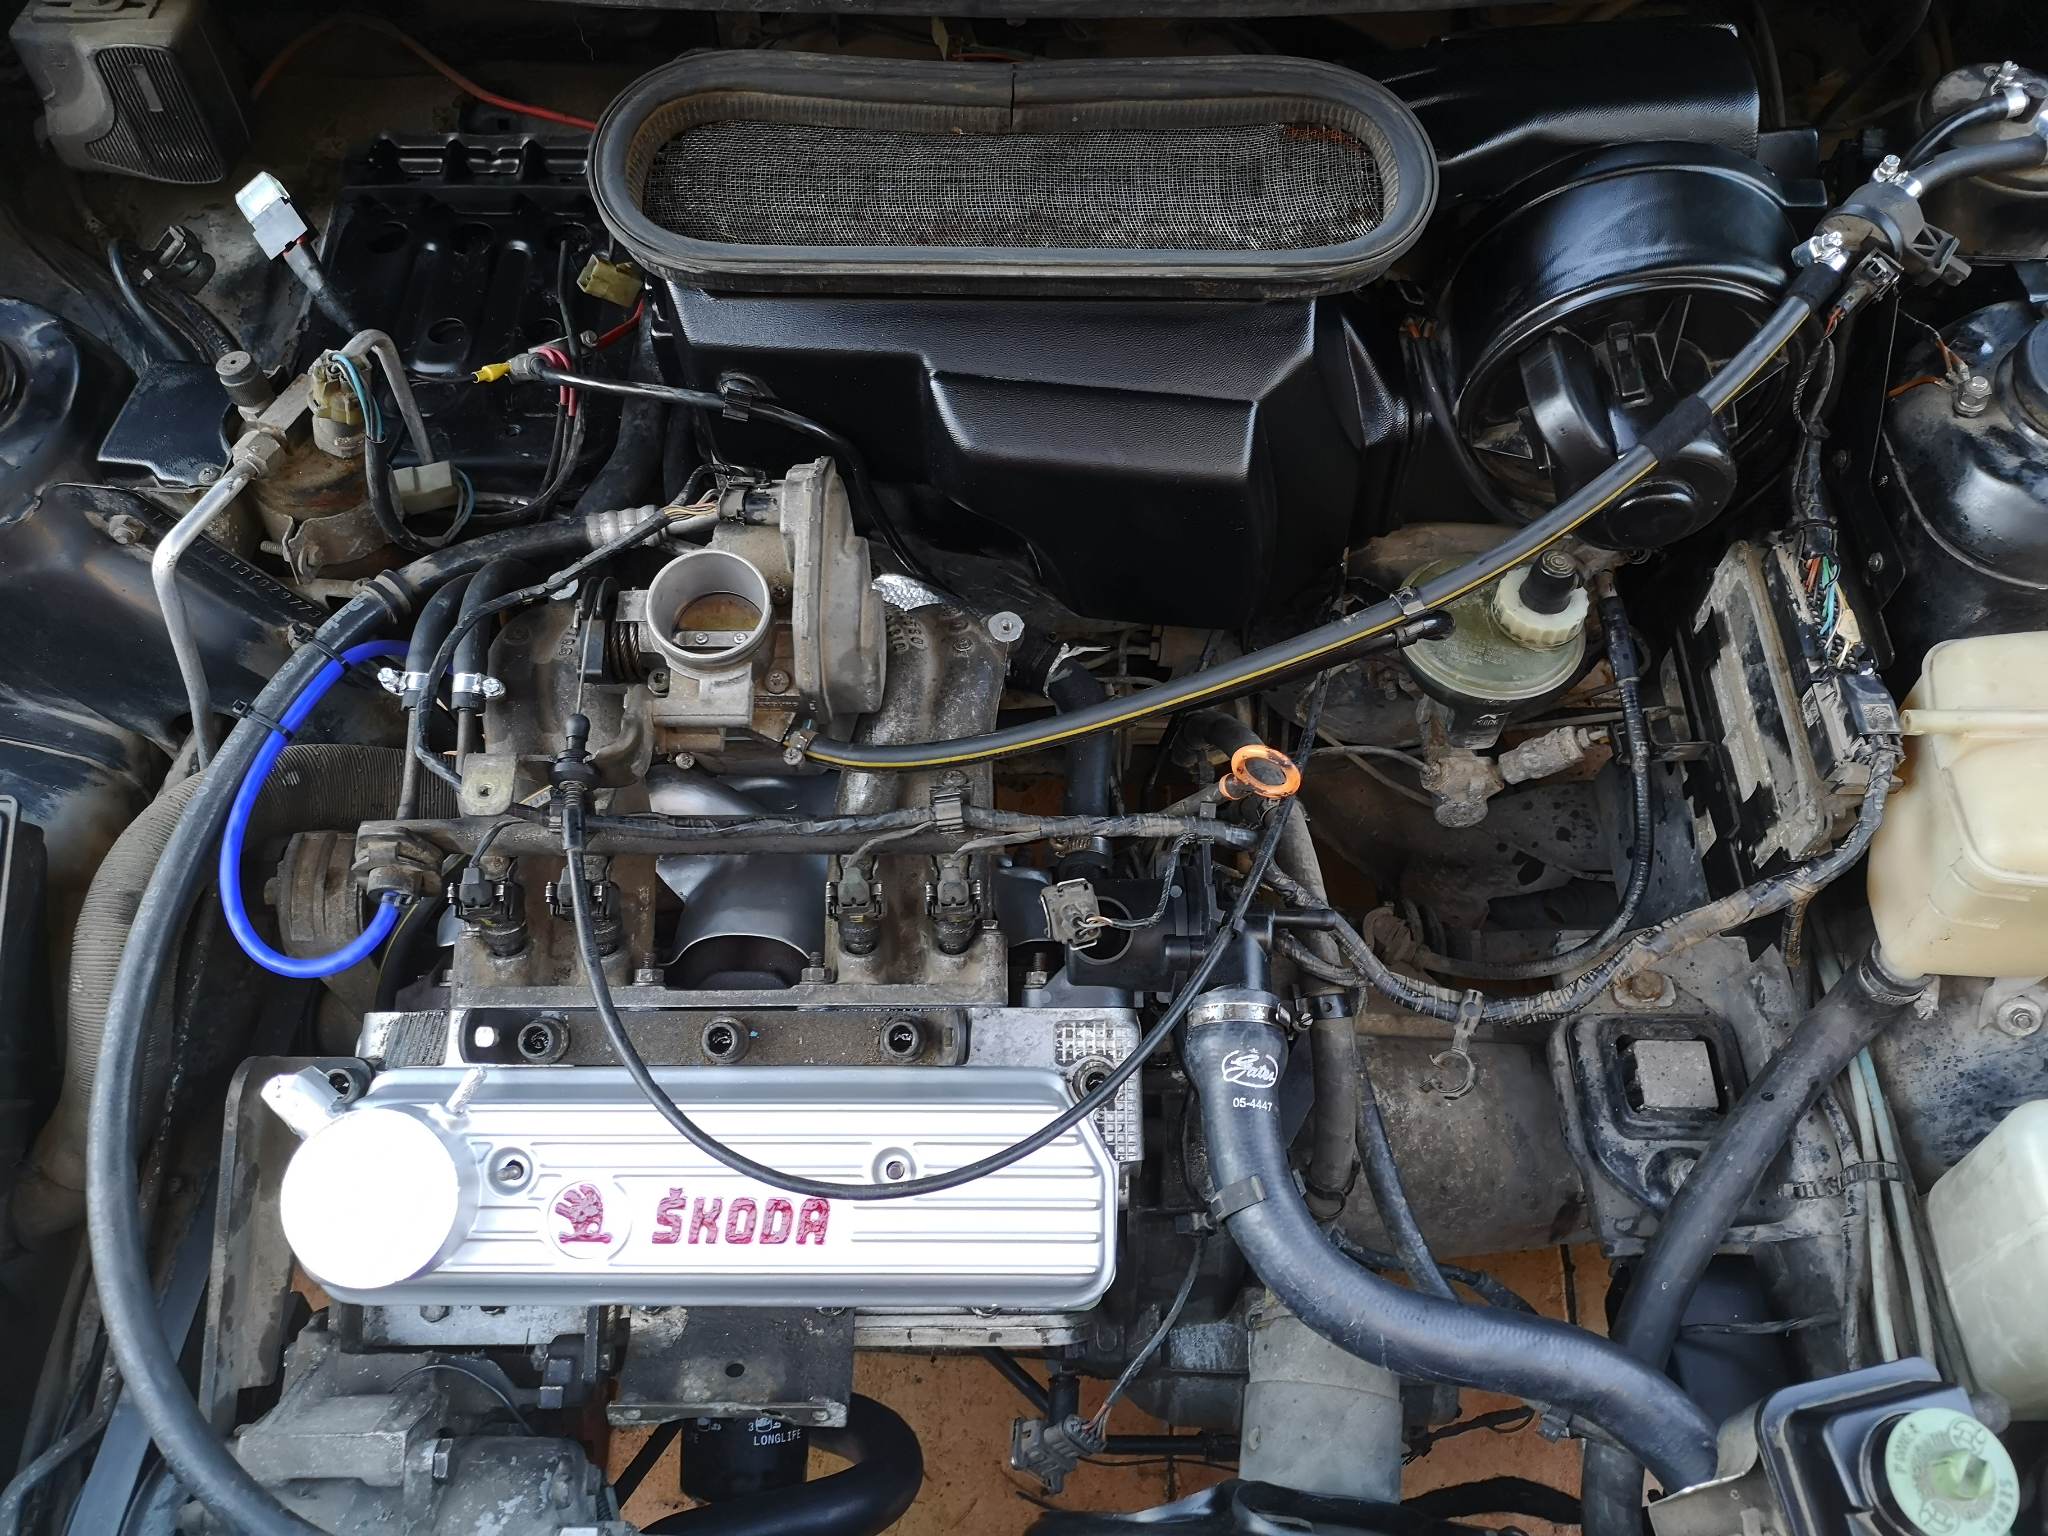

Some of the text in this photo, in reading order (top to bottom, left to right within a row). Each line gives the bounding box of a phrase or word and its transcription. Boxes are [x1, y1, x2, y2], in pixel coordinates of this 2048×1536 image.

[1232, 1097, 1273, 1112] 05-4447
[651, 1187, 831, 1245] ŠKODA
[753, 1428, 801, 1446] LONGLIFE
